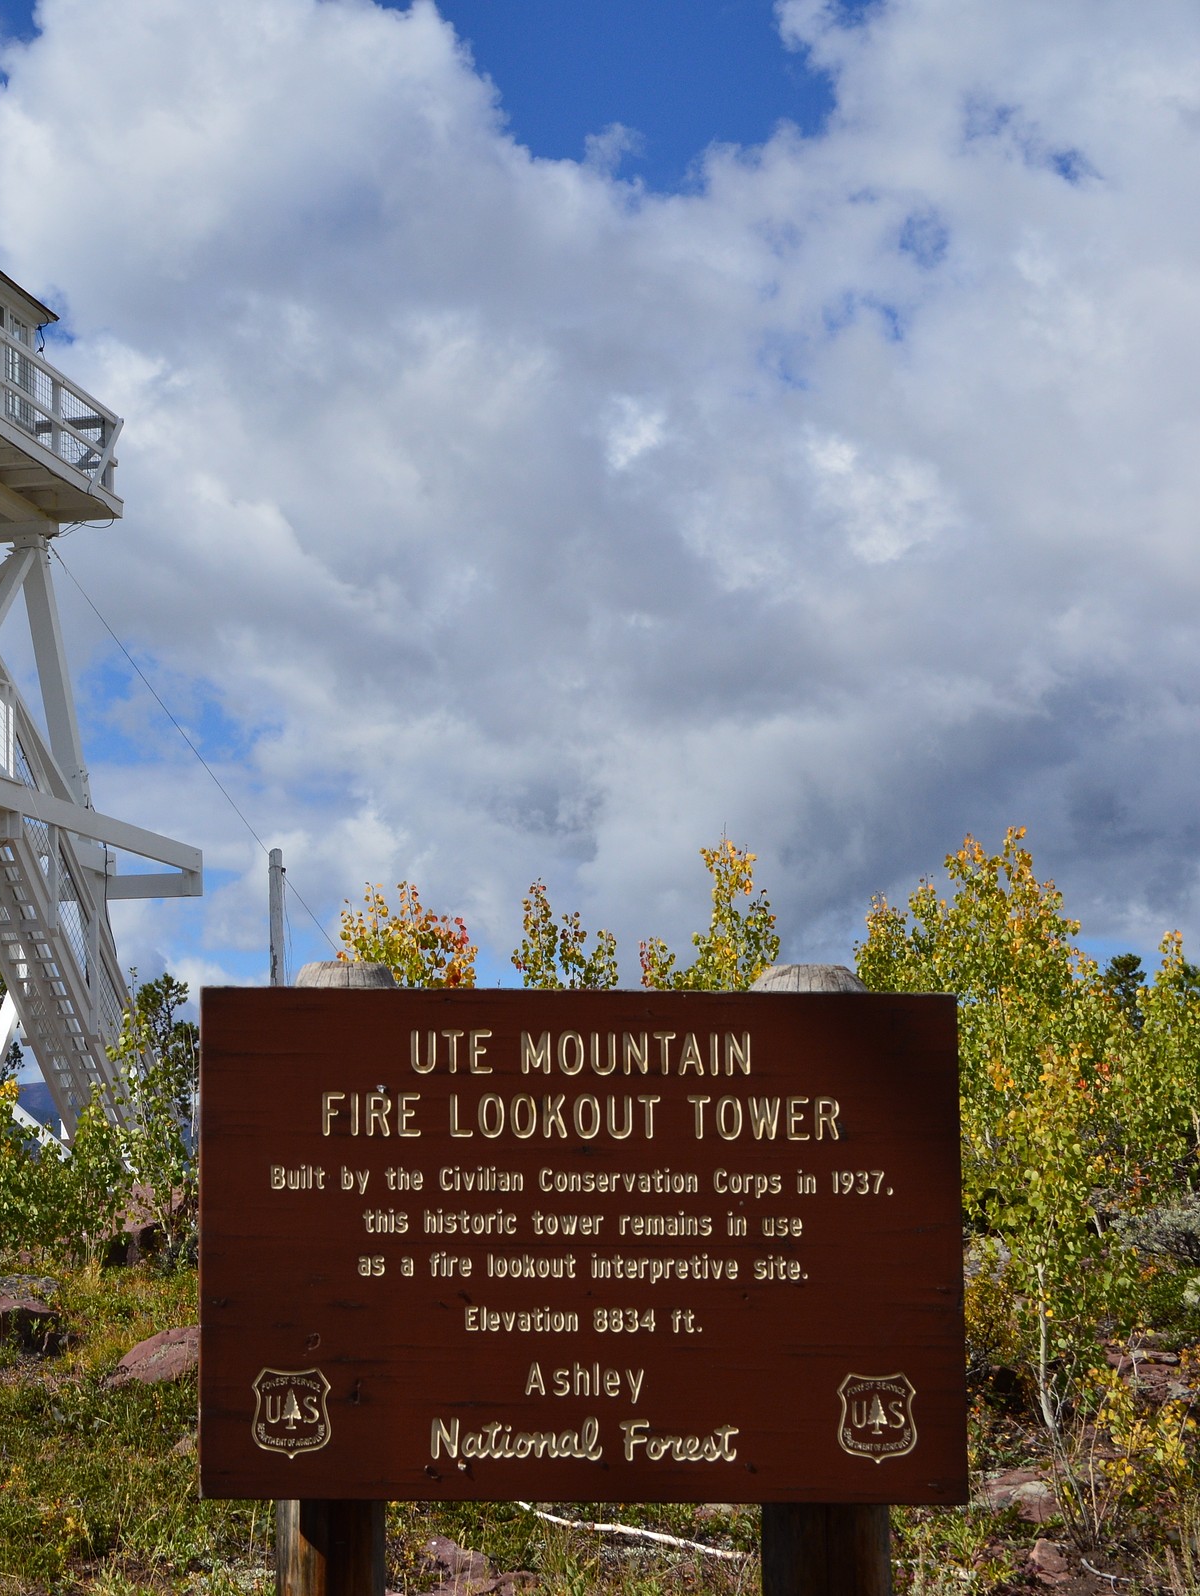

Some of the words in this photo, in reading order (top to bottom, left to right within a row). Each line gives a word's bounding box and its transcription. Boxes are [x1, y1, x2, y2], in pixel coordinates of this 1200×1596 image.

[410, 1029, 494, 1075] UTE
[520, 1031, 751, 1077] MOUNTAIN
[322, 1091, 422, 1138] FIRE
[449, 1094, 661, 1140] LOOKOUT
[687, 1095, 840, 1141] TOWER
[270, 1164, 326, 1190] Built
[340, 1165, 370, 1195] by
[384, 1166, 424, 1191] the
[439, 1165, 524, 1192] Civilian
[538, 1167, 699, 1194] Conservation
[713, 1169, 782, 1199] Corps
[797, 1169, 817, 1195] in
[362, 1208, 409, 1234] this
[423, 1208, 517, 1235] historic
[531, 1210, 605, 1236] tower
[619, 1210, 713, 1237] remains
[727, 1211, 747, 1237] in
[762, 1217, 803, 1238] use
[357, 1256, 386, 1277] as
[400, 1257, 414, 1277] a
[428, 1251, 473, 1278] fire
[487, 1253, 577, 1279] lookout
[591, 1252, 739, 1285] interpretive
[753, 1254, 809, 1281] site.
[464, 1306, 579, 1333] Elevation
[593, 1308, 657, 1334] 8834
[670, 1309, 703, 1334] ft.
[290, 1376, 321, 1393] SERVICE
[525, 1362, 645, 1405] Ashley
[876, 1381, 907, 1398] SERVICE
[430, 1417, 603, 1461] National
[619, 1420, 740, 1463] Forest
